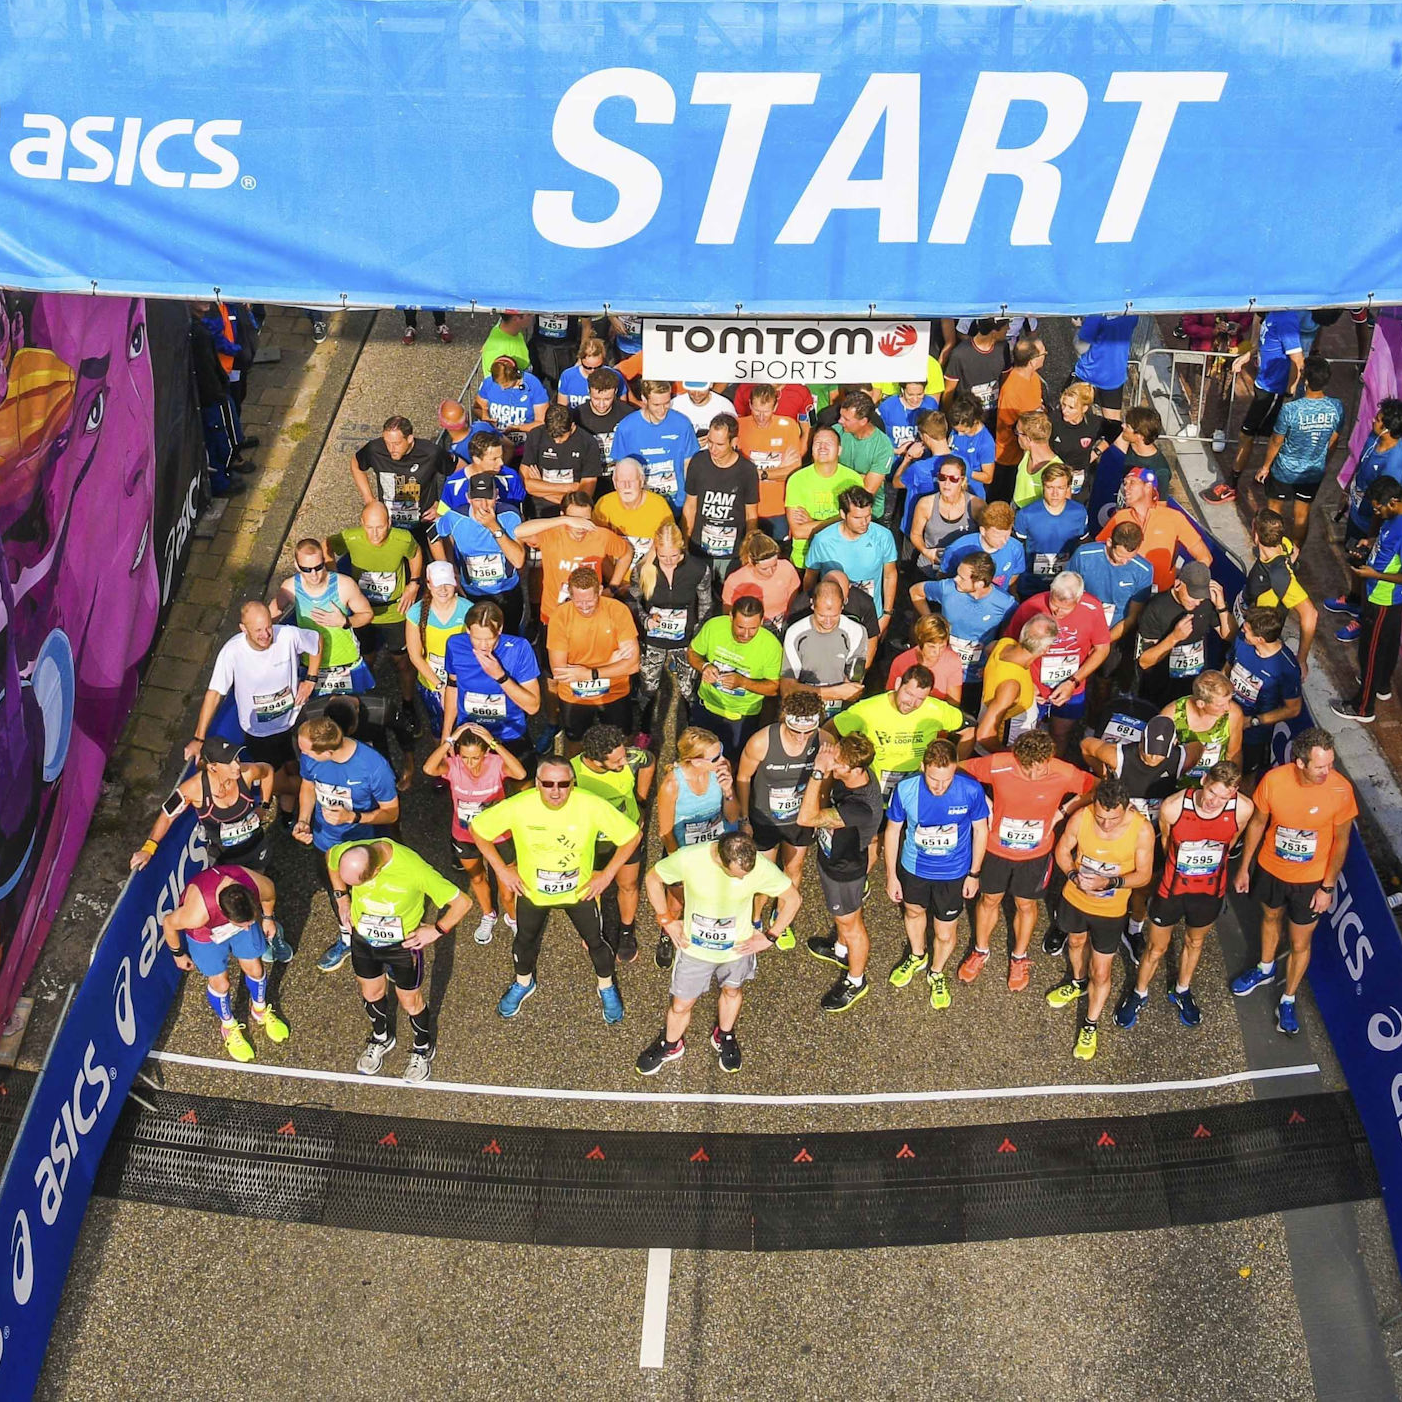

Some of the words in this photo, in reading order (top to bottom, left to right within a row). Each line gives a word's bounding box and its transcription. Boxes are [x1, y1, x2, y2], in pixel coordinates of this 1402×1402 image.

[8, 113, 243, 190] asics
[531, 66, 1230, 250] START
[543, 321, 562, 330] 7453
[656, 325, 873, 356] TOMTOM
[735, 360, 838, 381] SPORTS
[489, 403, 528, 421] RIGHT
[704, 491, 736, 506] DAM
[701, 504, 735, 521] FAST.
[473, 568, 497, 578] 7366
[365, 583, 389, 593] 7059
[1177, 657, 1199, 668] 7525
[1048, 668, 1072, 679] 7538
[262, 699, 287, 712] 7946
[921, 837, 950, 847] 6514
[1007, 831, 1035, 841] 6725
[1281, 840, 1309, 853] 7535
[1185, 855, 1213, 865] 7595
[544, 882, 572, 892] 6219
[1330, 870, 1375, 982] sics
[366, 927, 395, 939] 7909
[698, 929, 727, 941] 7603
[34, 1041, 114, 1227] asics
